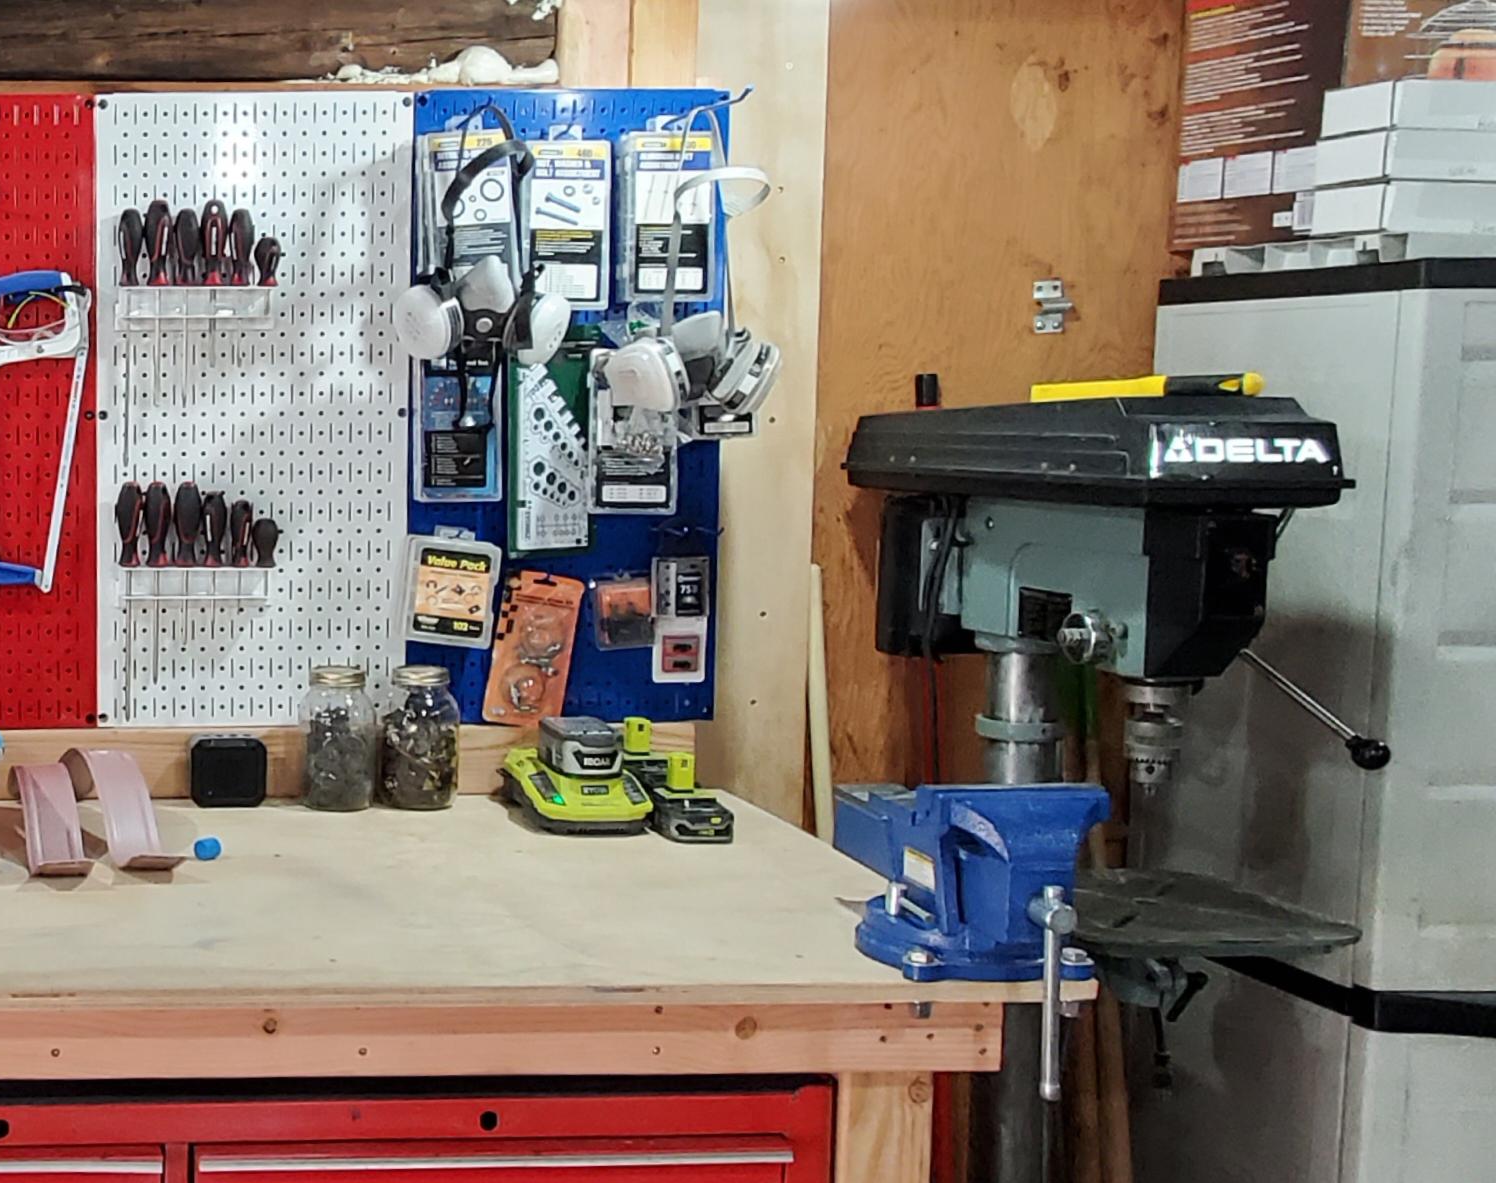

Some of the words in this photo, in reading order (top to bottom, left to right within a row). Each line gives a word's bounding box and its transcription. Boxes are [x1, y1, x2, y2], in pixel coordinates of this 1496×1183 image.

[1194, 437, 1332, 464] DELTA
[426, 555, 458, 569] Value
[459, 559, 487, 572] Pack
